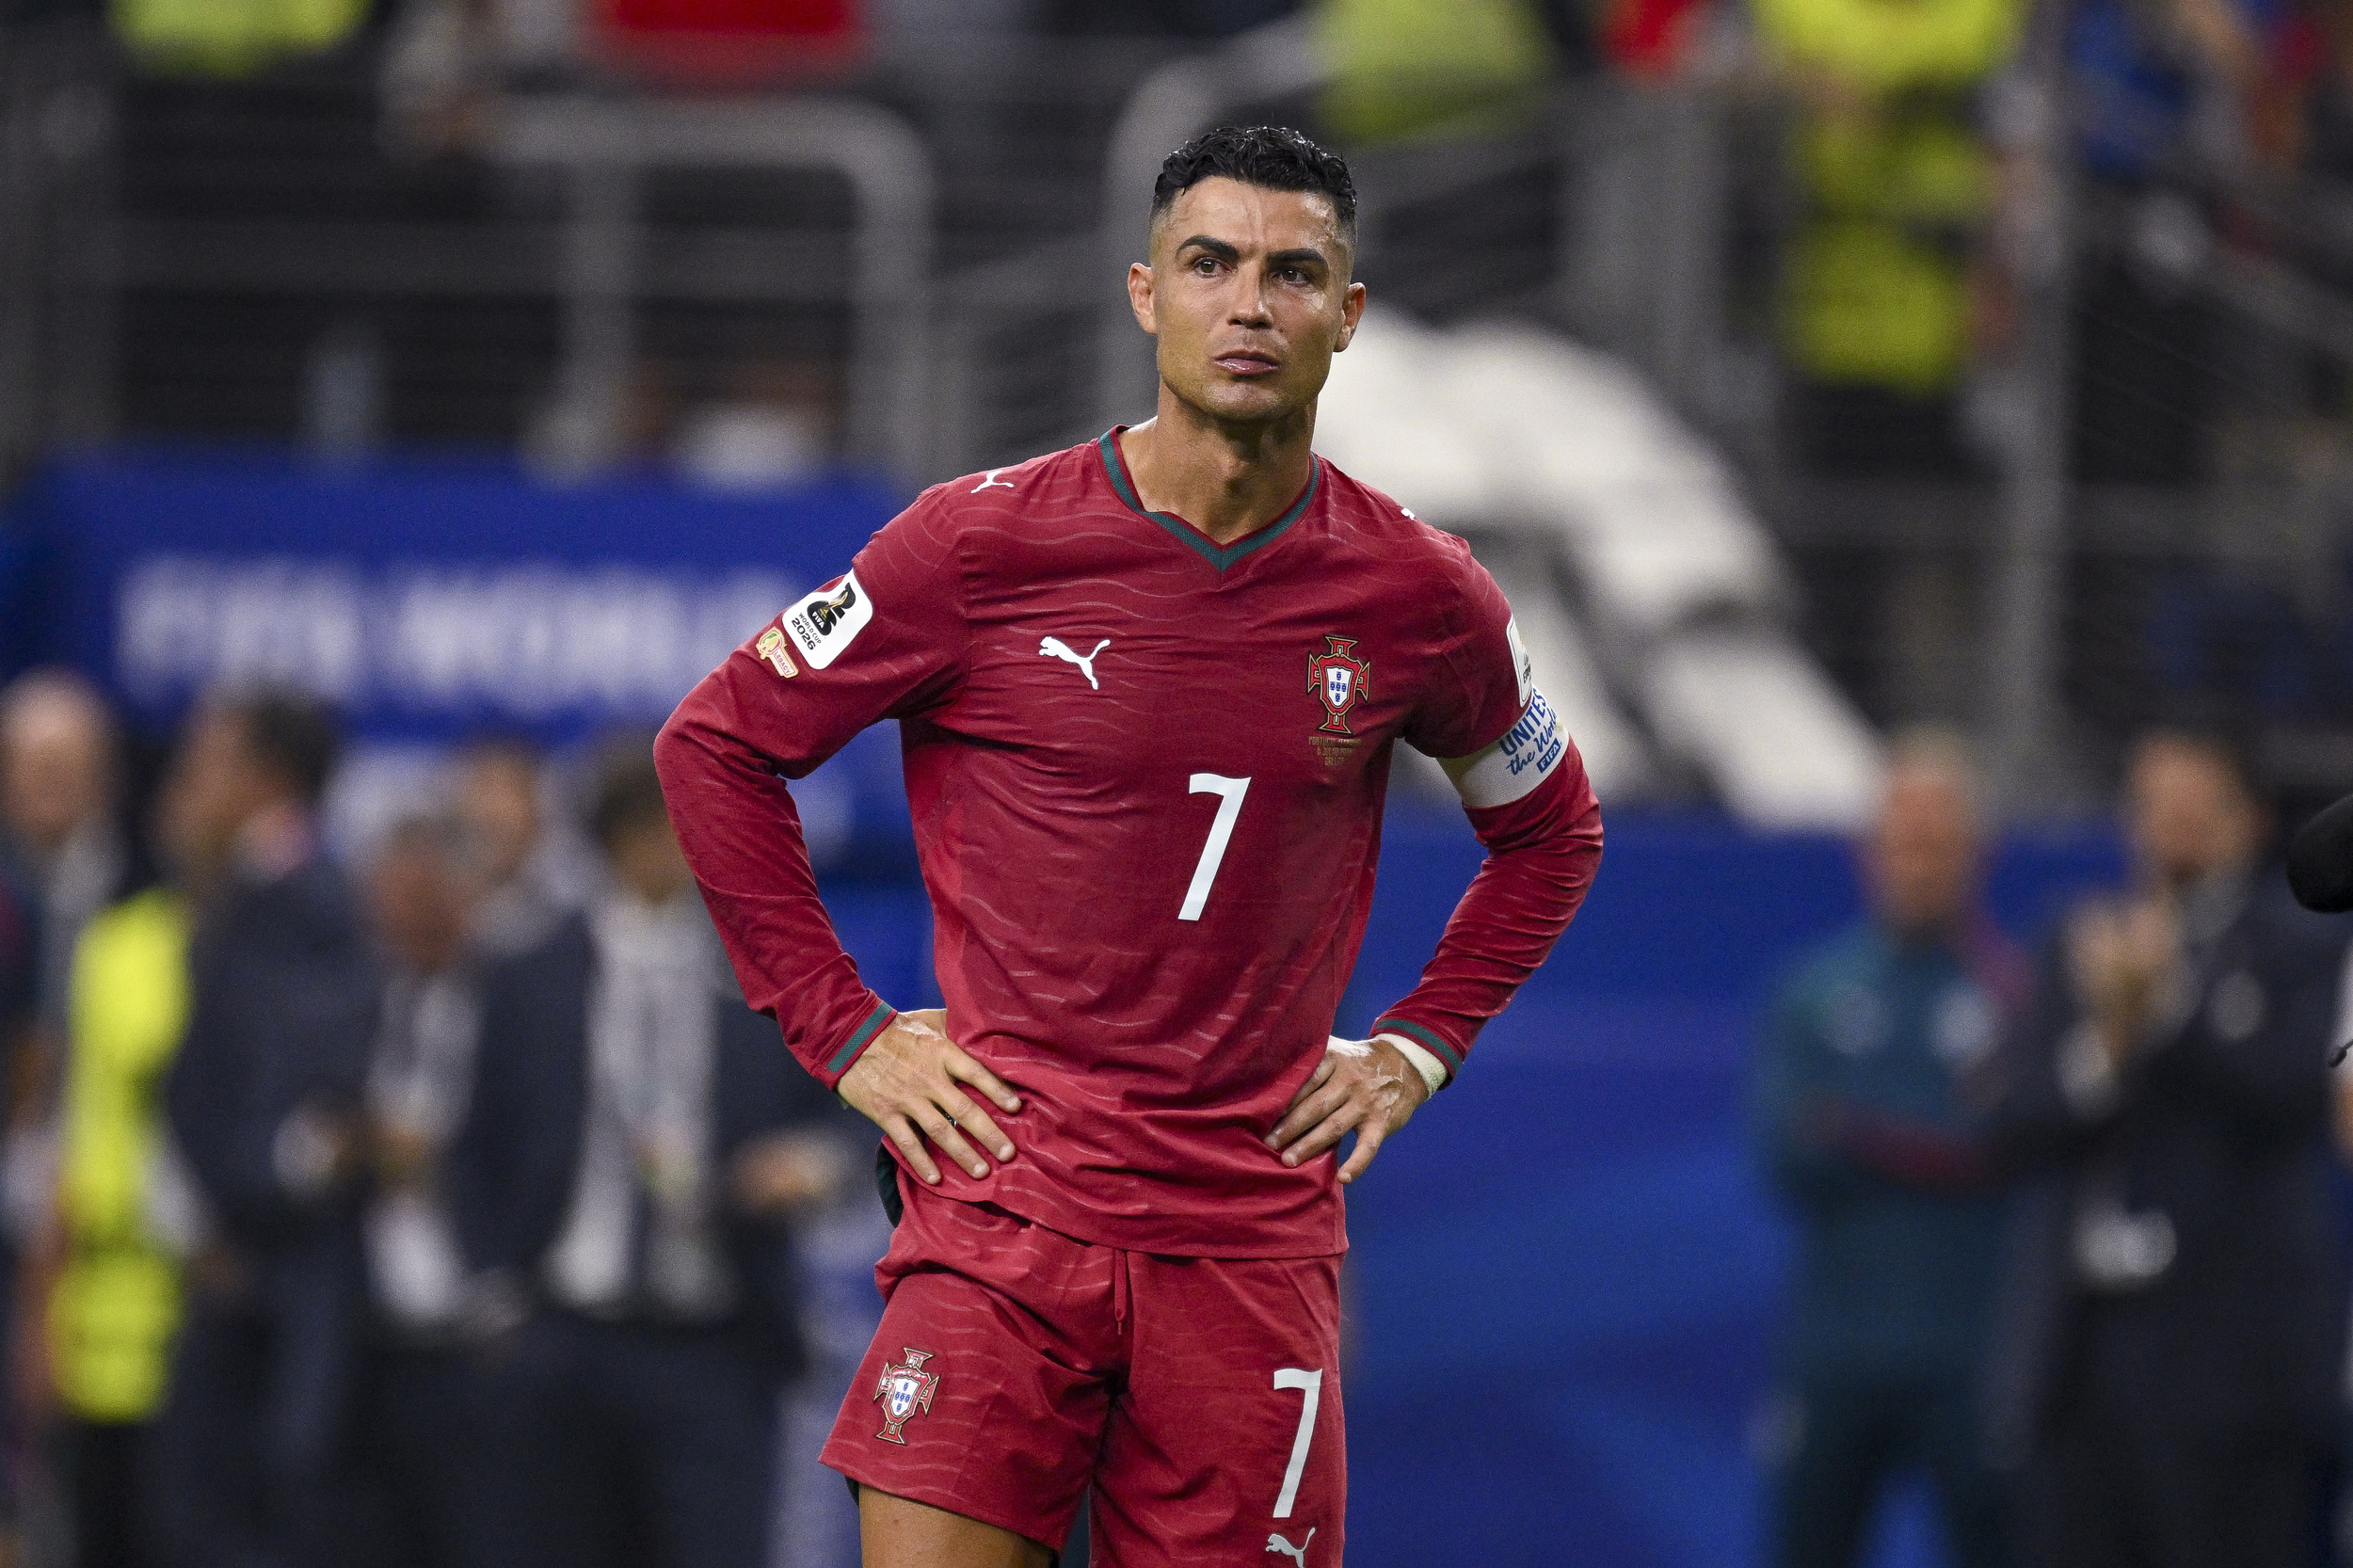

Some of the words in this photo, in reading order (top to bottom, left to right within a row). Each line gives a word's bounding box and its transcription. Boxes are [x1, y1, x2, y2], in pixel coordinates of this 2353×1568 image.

[791, 616, 816, 650] 2026
[798, 612, 814, 633] WORLD
[811, 632, 822, 644] CUP
[811, 611, 824, 629] FIFA
[774, 651, 791, 674] LEGACY
[1499, 688, 1546, 756] UNITES
[1506, 751, 1536, 776] the
[1539, 743, 1560, 769] FIFA
[1178, 773, 1252, 920] 7
[1273, 1368, 1322, 1518] 7
